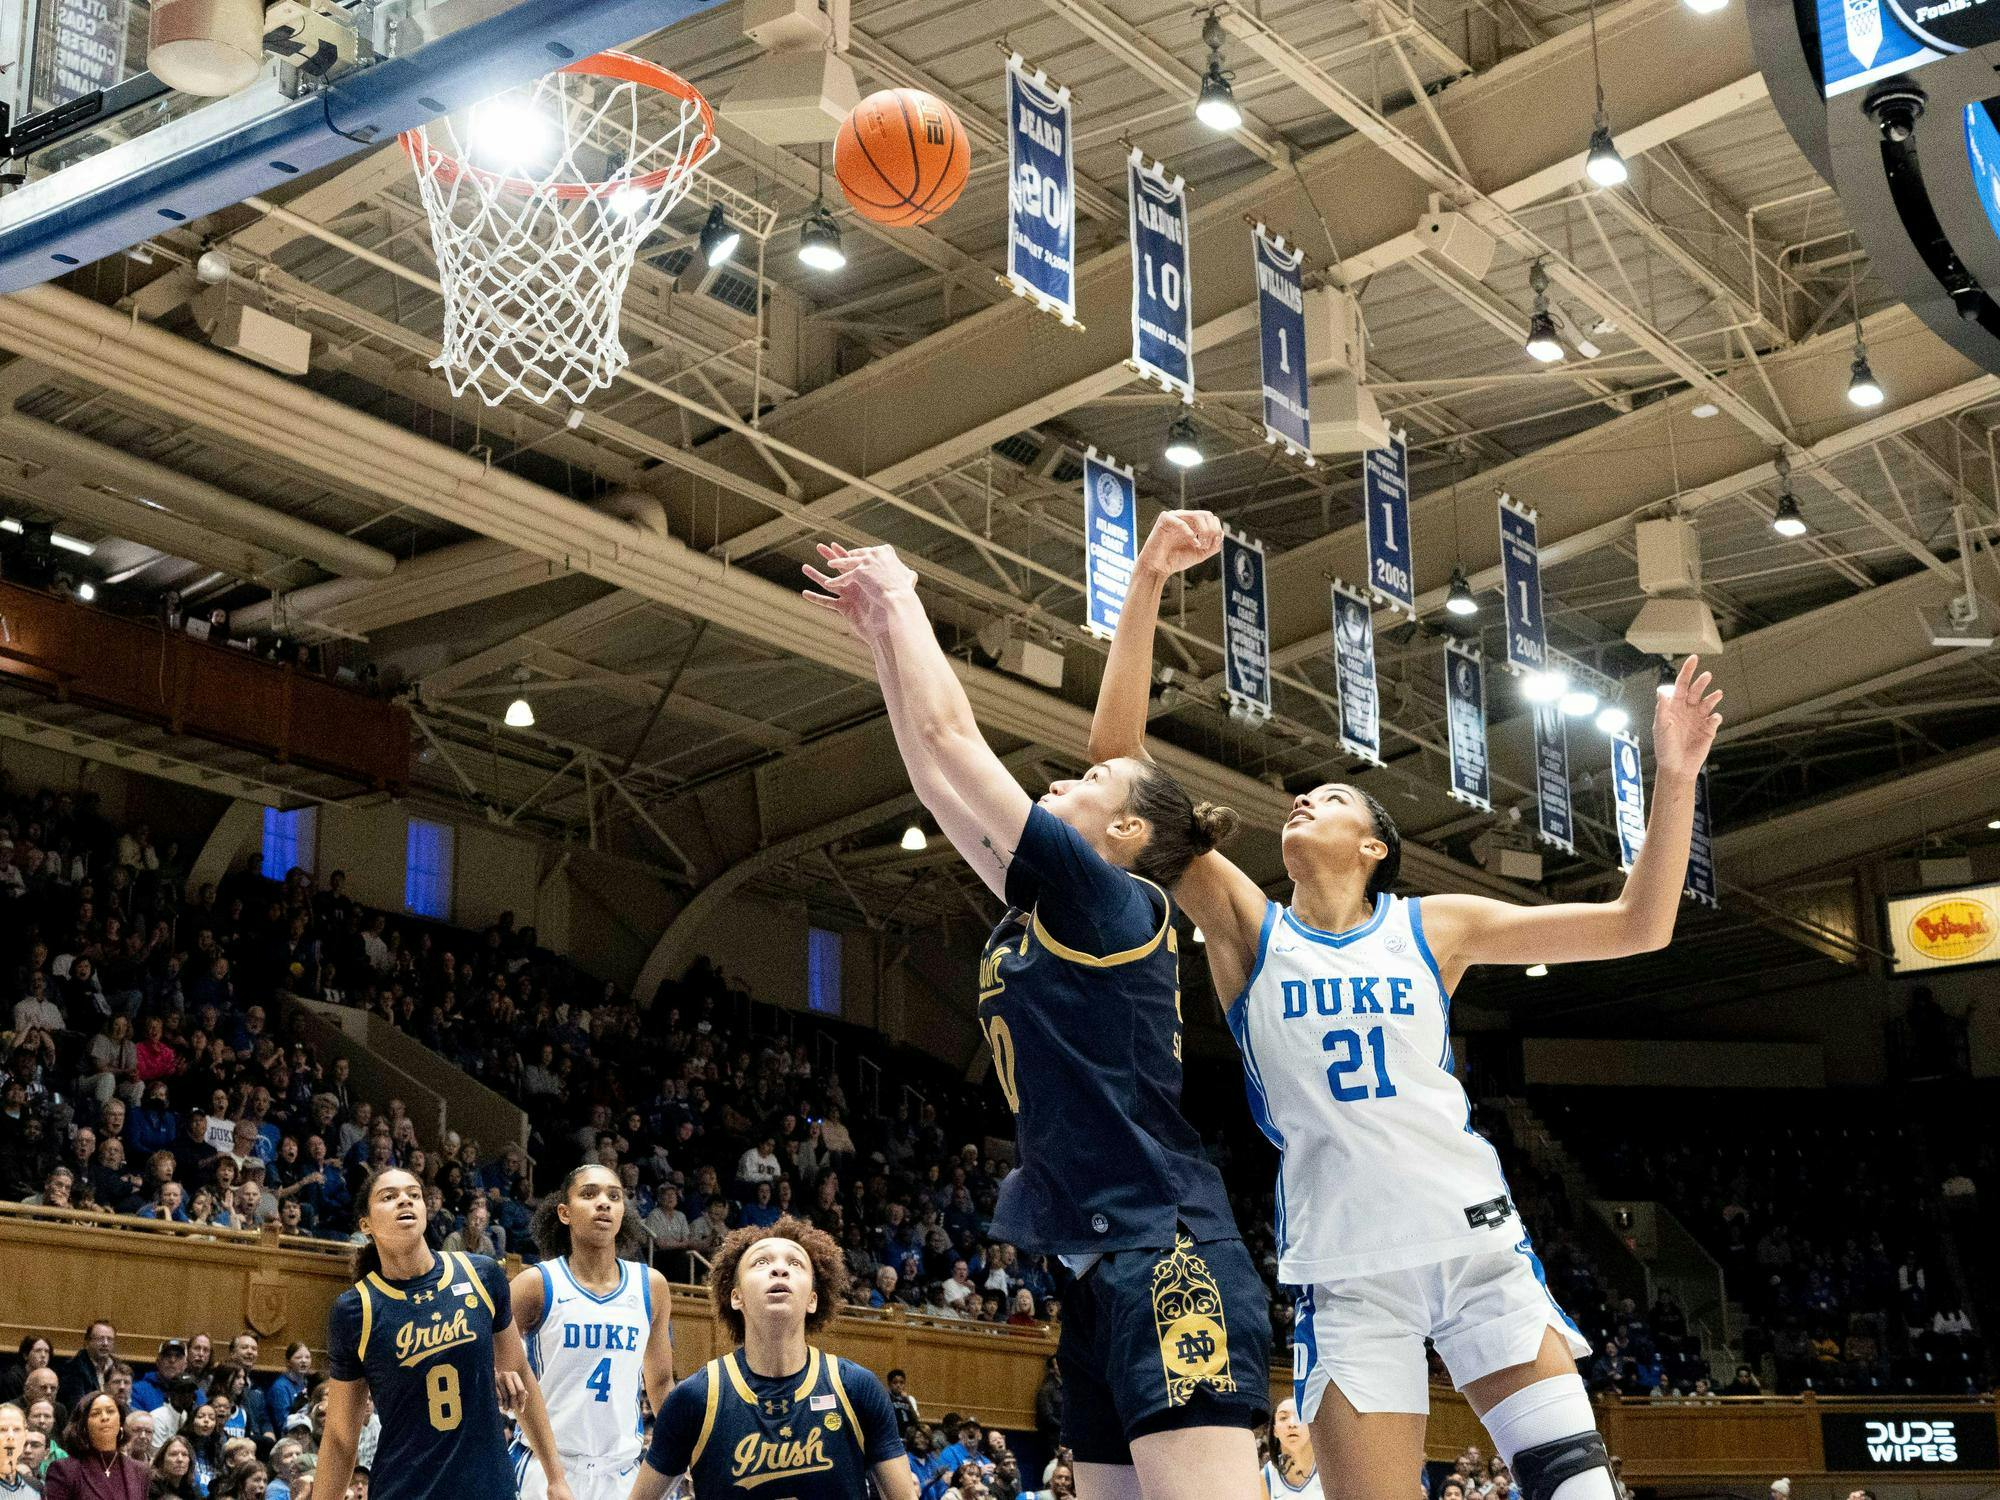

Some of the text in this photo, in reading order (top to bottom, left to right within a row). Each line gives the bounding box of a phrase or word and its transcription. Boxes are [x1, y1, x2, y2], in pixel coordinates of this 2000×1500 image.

[1018, 103, 1062, 157] BEARD
[1019, 162, 1061, 230] 20
[1144, 253, 1180, 312] 10
[1258, 260, 1303, 315] WILLIAMS
[1278, 327, 1291, 374] 1
[1381, 502, 1398, 552] 1
[1376, 557, 1408, 593] 2003
[1518, 580, 1532, 627] 1
[1515, 632, 1543, 665] 2004
[1280, 977, 1415, 1020] DUKE
[1322, 1026, 1397, 1102] 21
[210, 1127, 233, 1143] DUK
[396, 1308, 477, 1362] Irish
[563, 1323, 640, 1352] DUKE
[426, 1363, 463, 1432] 8
[586, 1357, 612, 1402] 4
[732, 1427, 834, 1482] Irish
[1865, 1422, 1956, 1445] DUDE
[1867, 1444, 1958, 1462] WIPES
